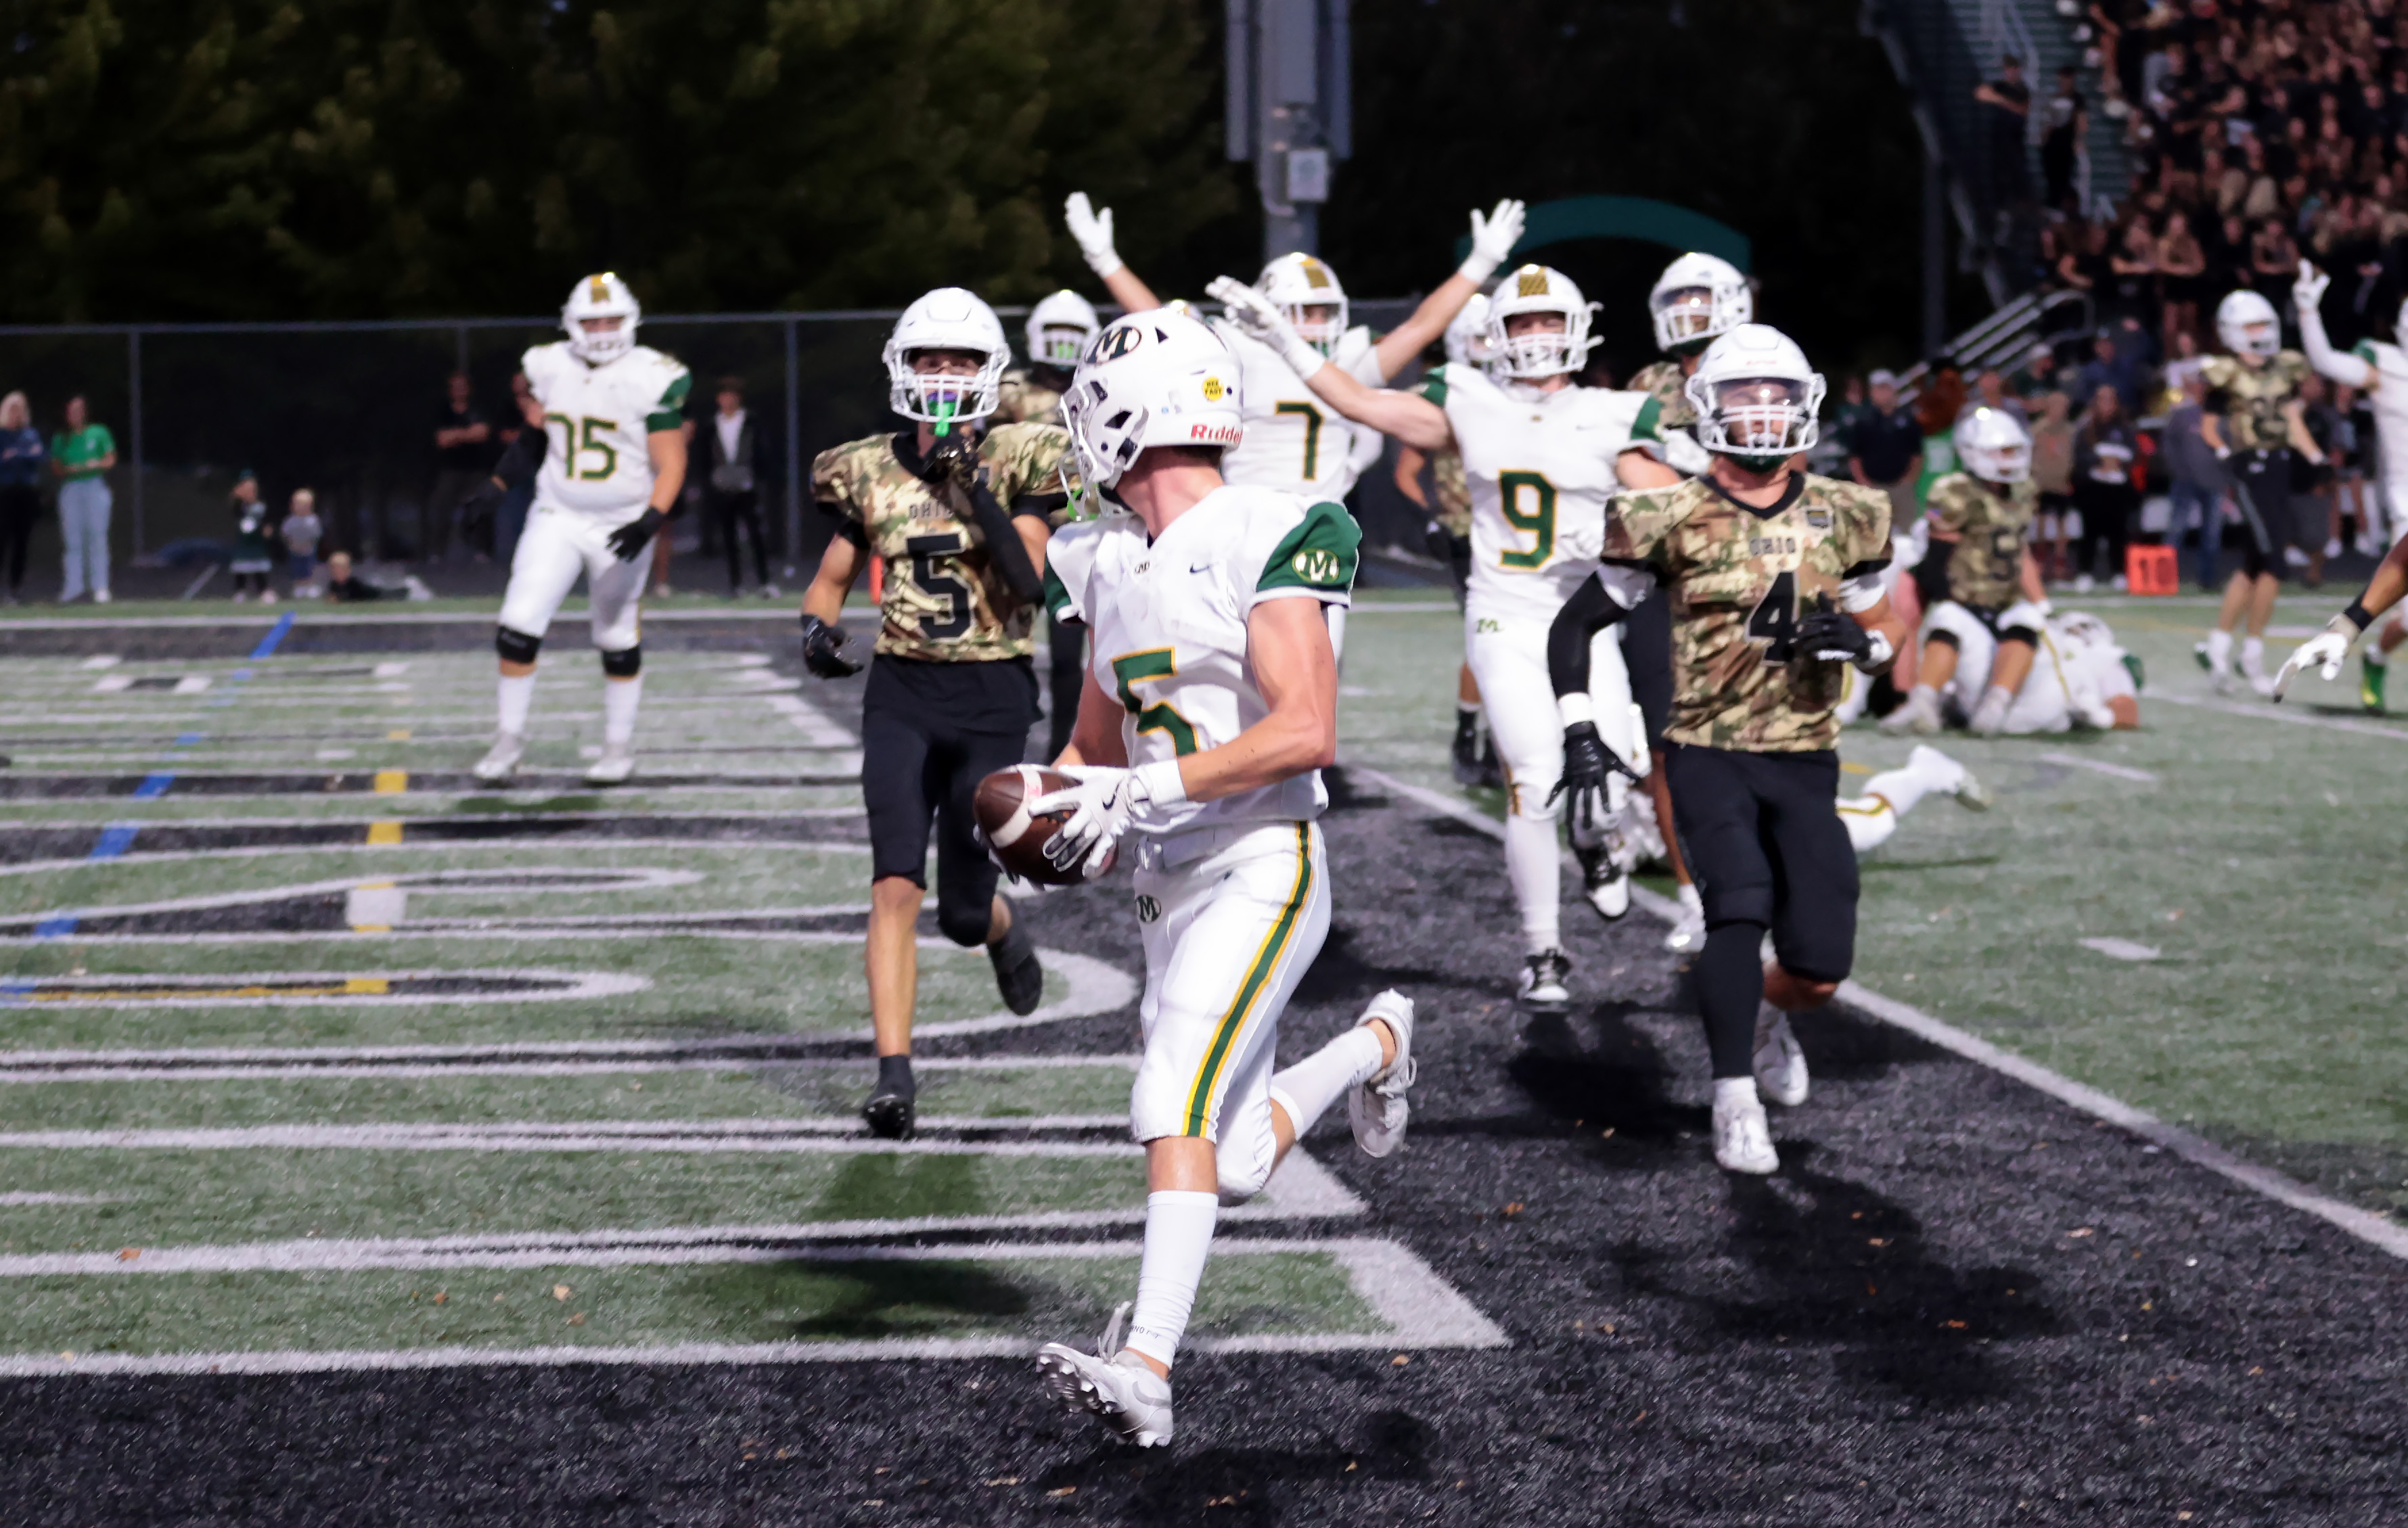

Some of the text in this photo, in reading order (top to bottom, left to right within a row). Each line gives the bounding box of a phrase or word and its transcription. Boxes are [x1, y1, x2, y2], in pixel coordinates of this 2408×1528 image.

[1085, 327, 1138, 364] M
[1275, 399, 1324, 482] 7
[1498, 468, 1558, 572] 9
[905, 532, 974, 641] 5
[1295, 550, 1337, 583] M
[1744, 570, 1800, 666] 4
[1111, 645, 1201, 756] 5
[1137, 895, 1160, 923] M
